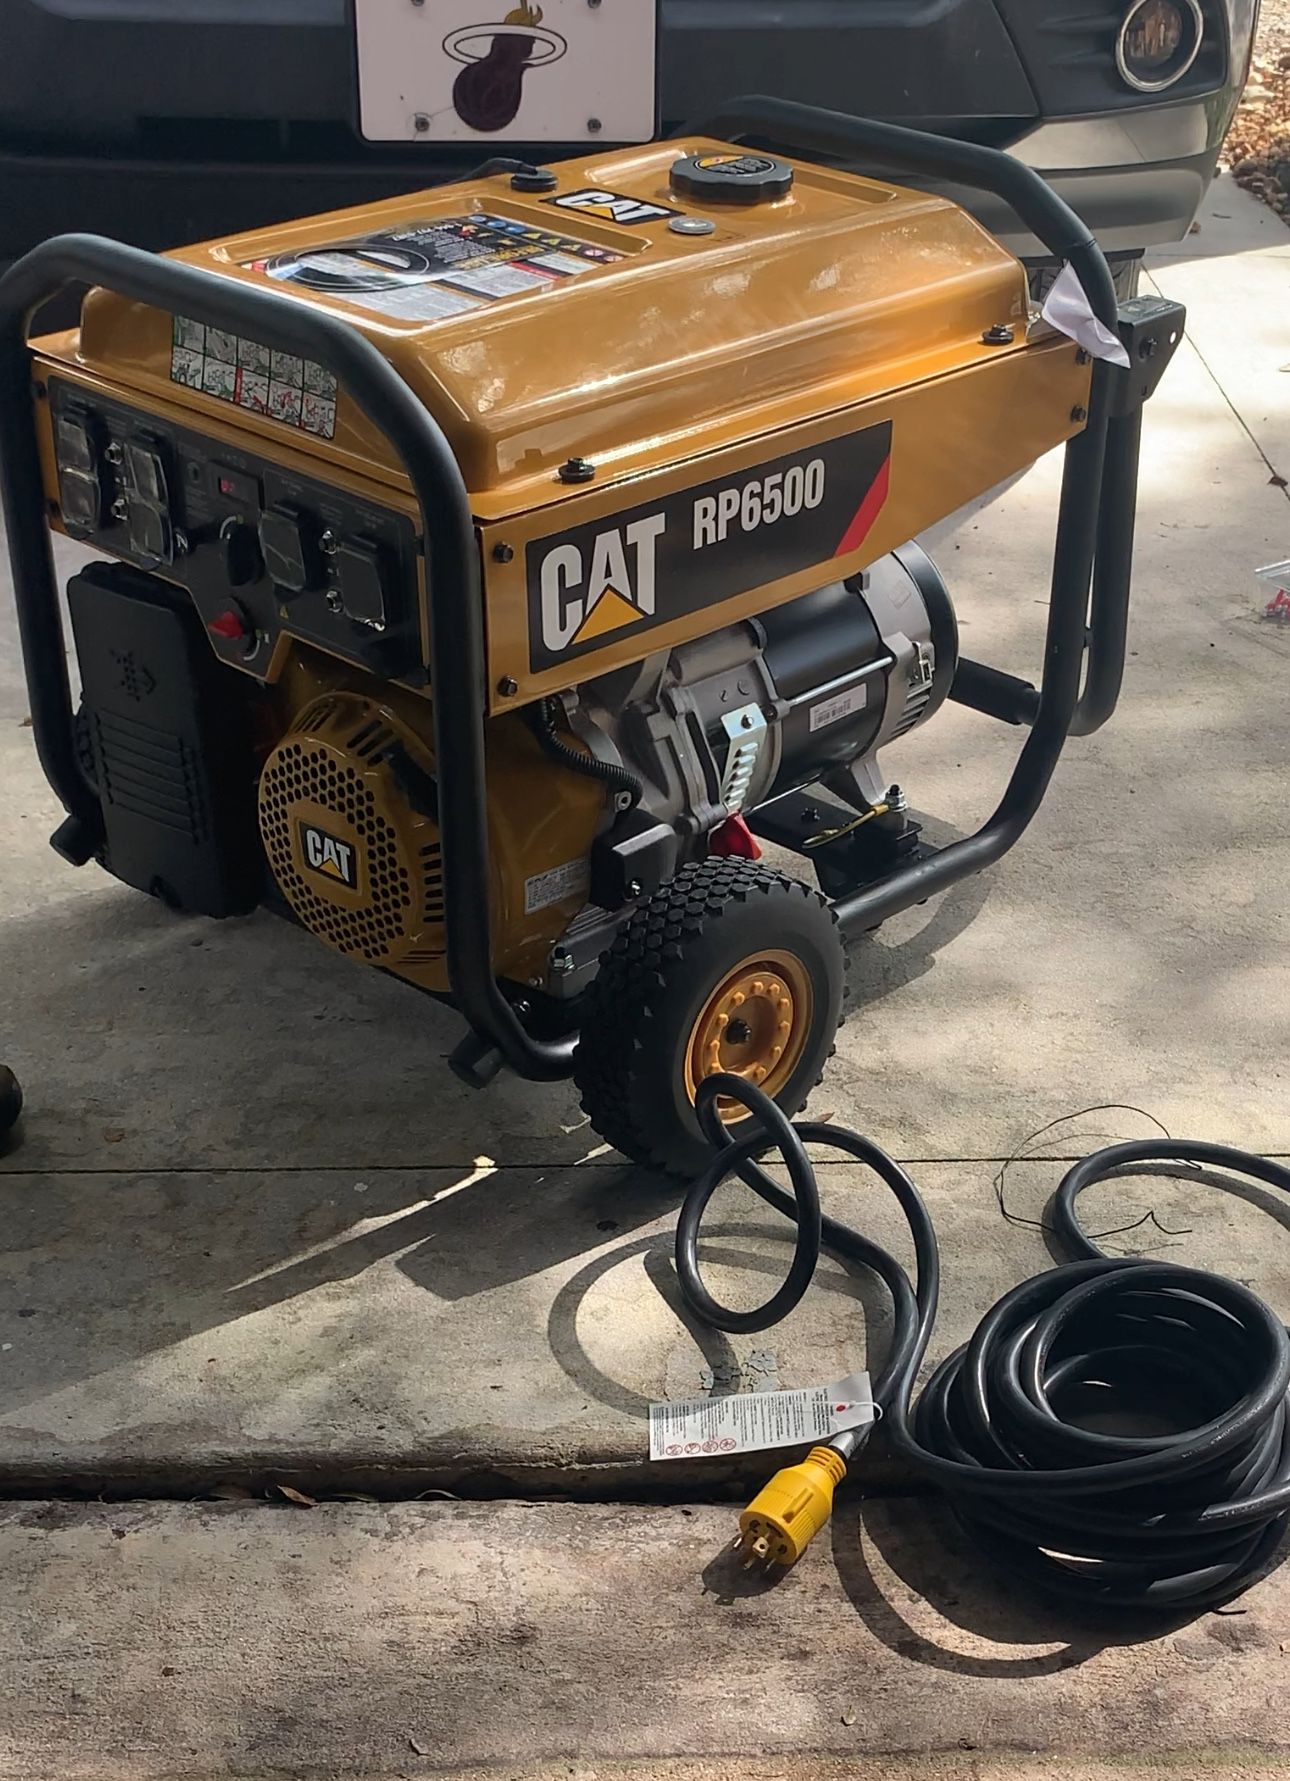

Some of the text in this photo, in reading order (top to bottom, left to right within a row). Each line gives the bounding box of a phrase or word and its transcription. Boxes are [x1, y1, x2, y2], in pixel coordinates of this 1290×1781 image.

[556, 191, 671, 221] CAT
[541, 458, 825, 651] CAT RP6500
[306, 830, 350, 882] CAT
